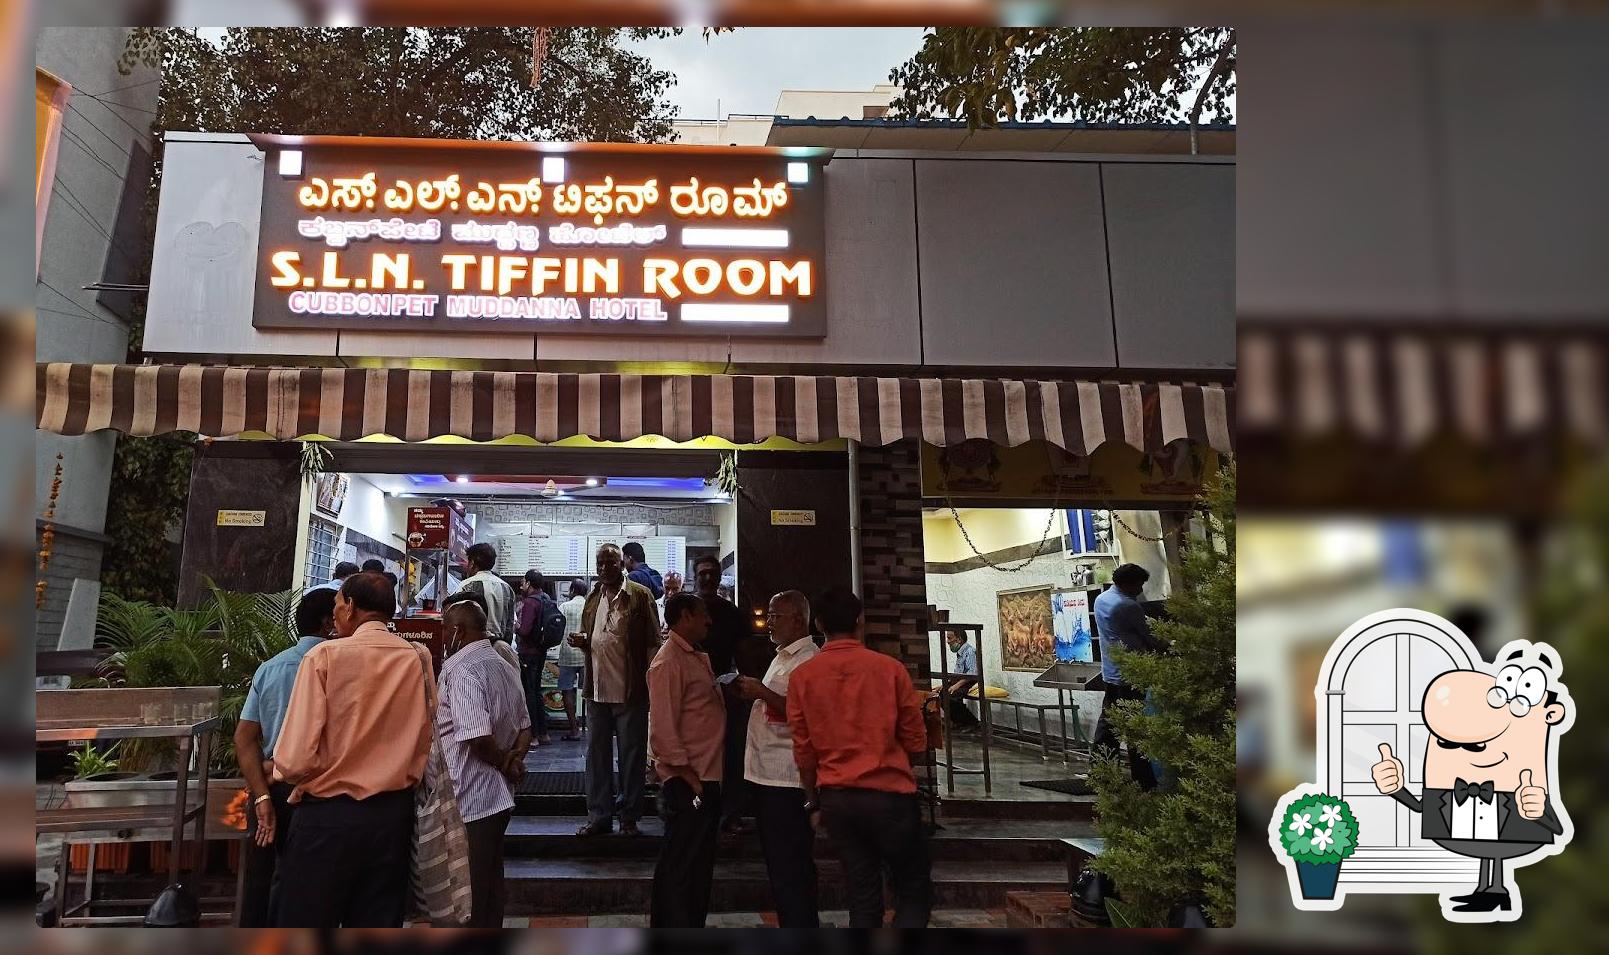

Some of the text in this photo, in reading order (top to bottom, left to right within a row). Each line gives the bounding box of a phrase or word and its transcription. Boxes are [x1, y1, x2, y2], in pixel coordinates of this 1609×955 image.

[299, 172, 788, 225] ಎಸ್. ಎಲ್. ಎನ್. ಟಿಫನ್ ರೂಮ್
[271, 252, 811, 299] S.L.N. TIFFIN ROOM
[289, 291, 668, 321] CUBBONPET MUDDANNA HOTEL
